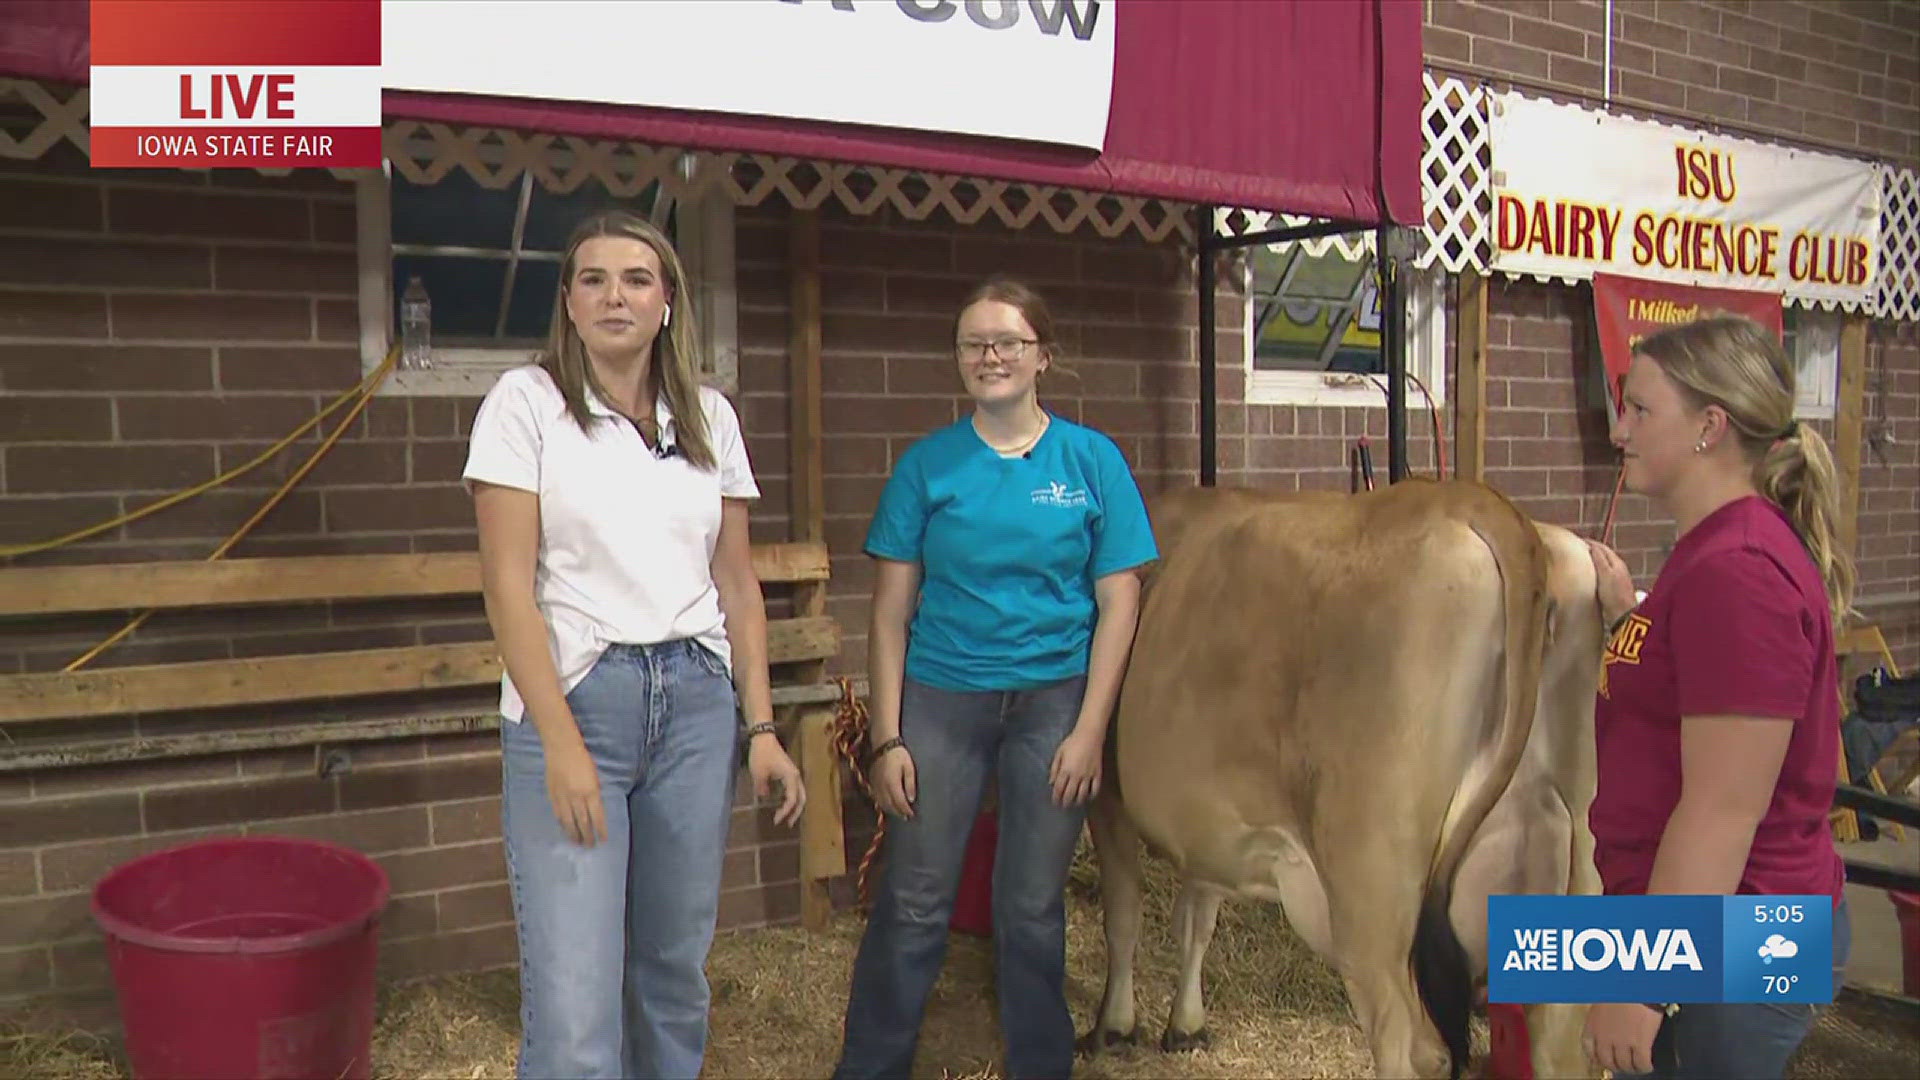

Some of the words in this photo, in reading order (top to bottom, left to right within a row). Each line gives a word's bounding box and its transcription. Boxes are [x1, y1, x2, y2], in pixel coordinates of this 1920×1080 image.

[1674, 145, 1736, 203] ISU
[1496, 194, 1621, 261] DAIRY
[1632, 212, 1778, 278] SCIENCE
[1788, 233, 1868, 285] CLUB
[1628, 299, 1636, 320] I
[1638, 301, 1698, 323] Milked
